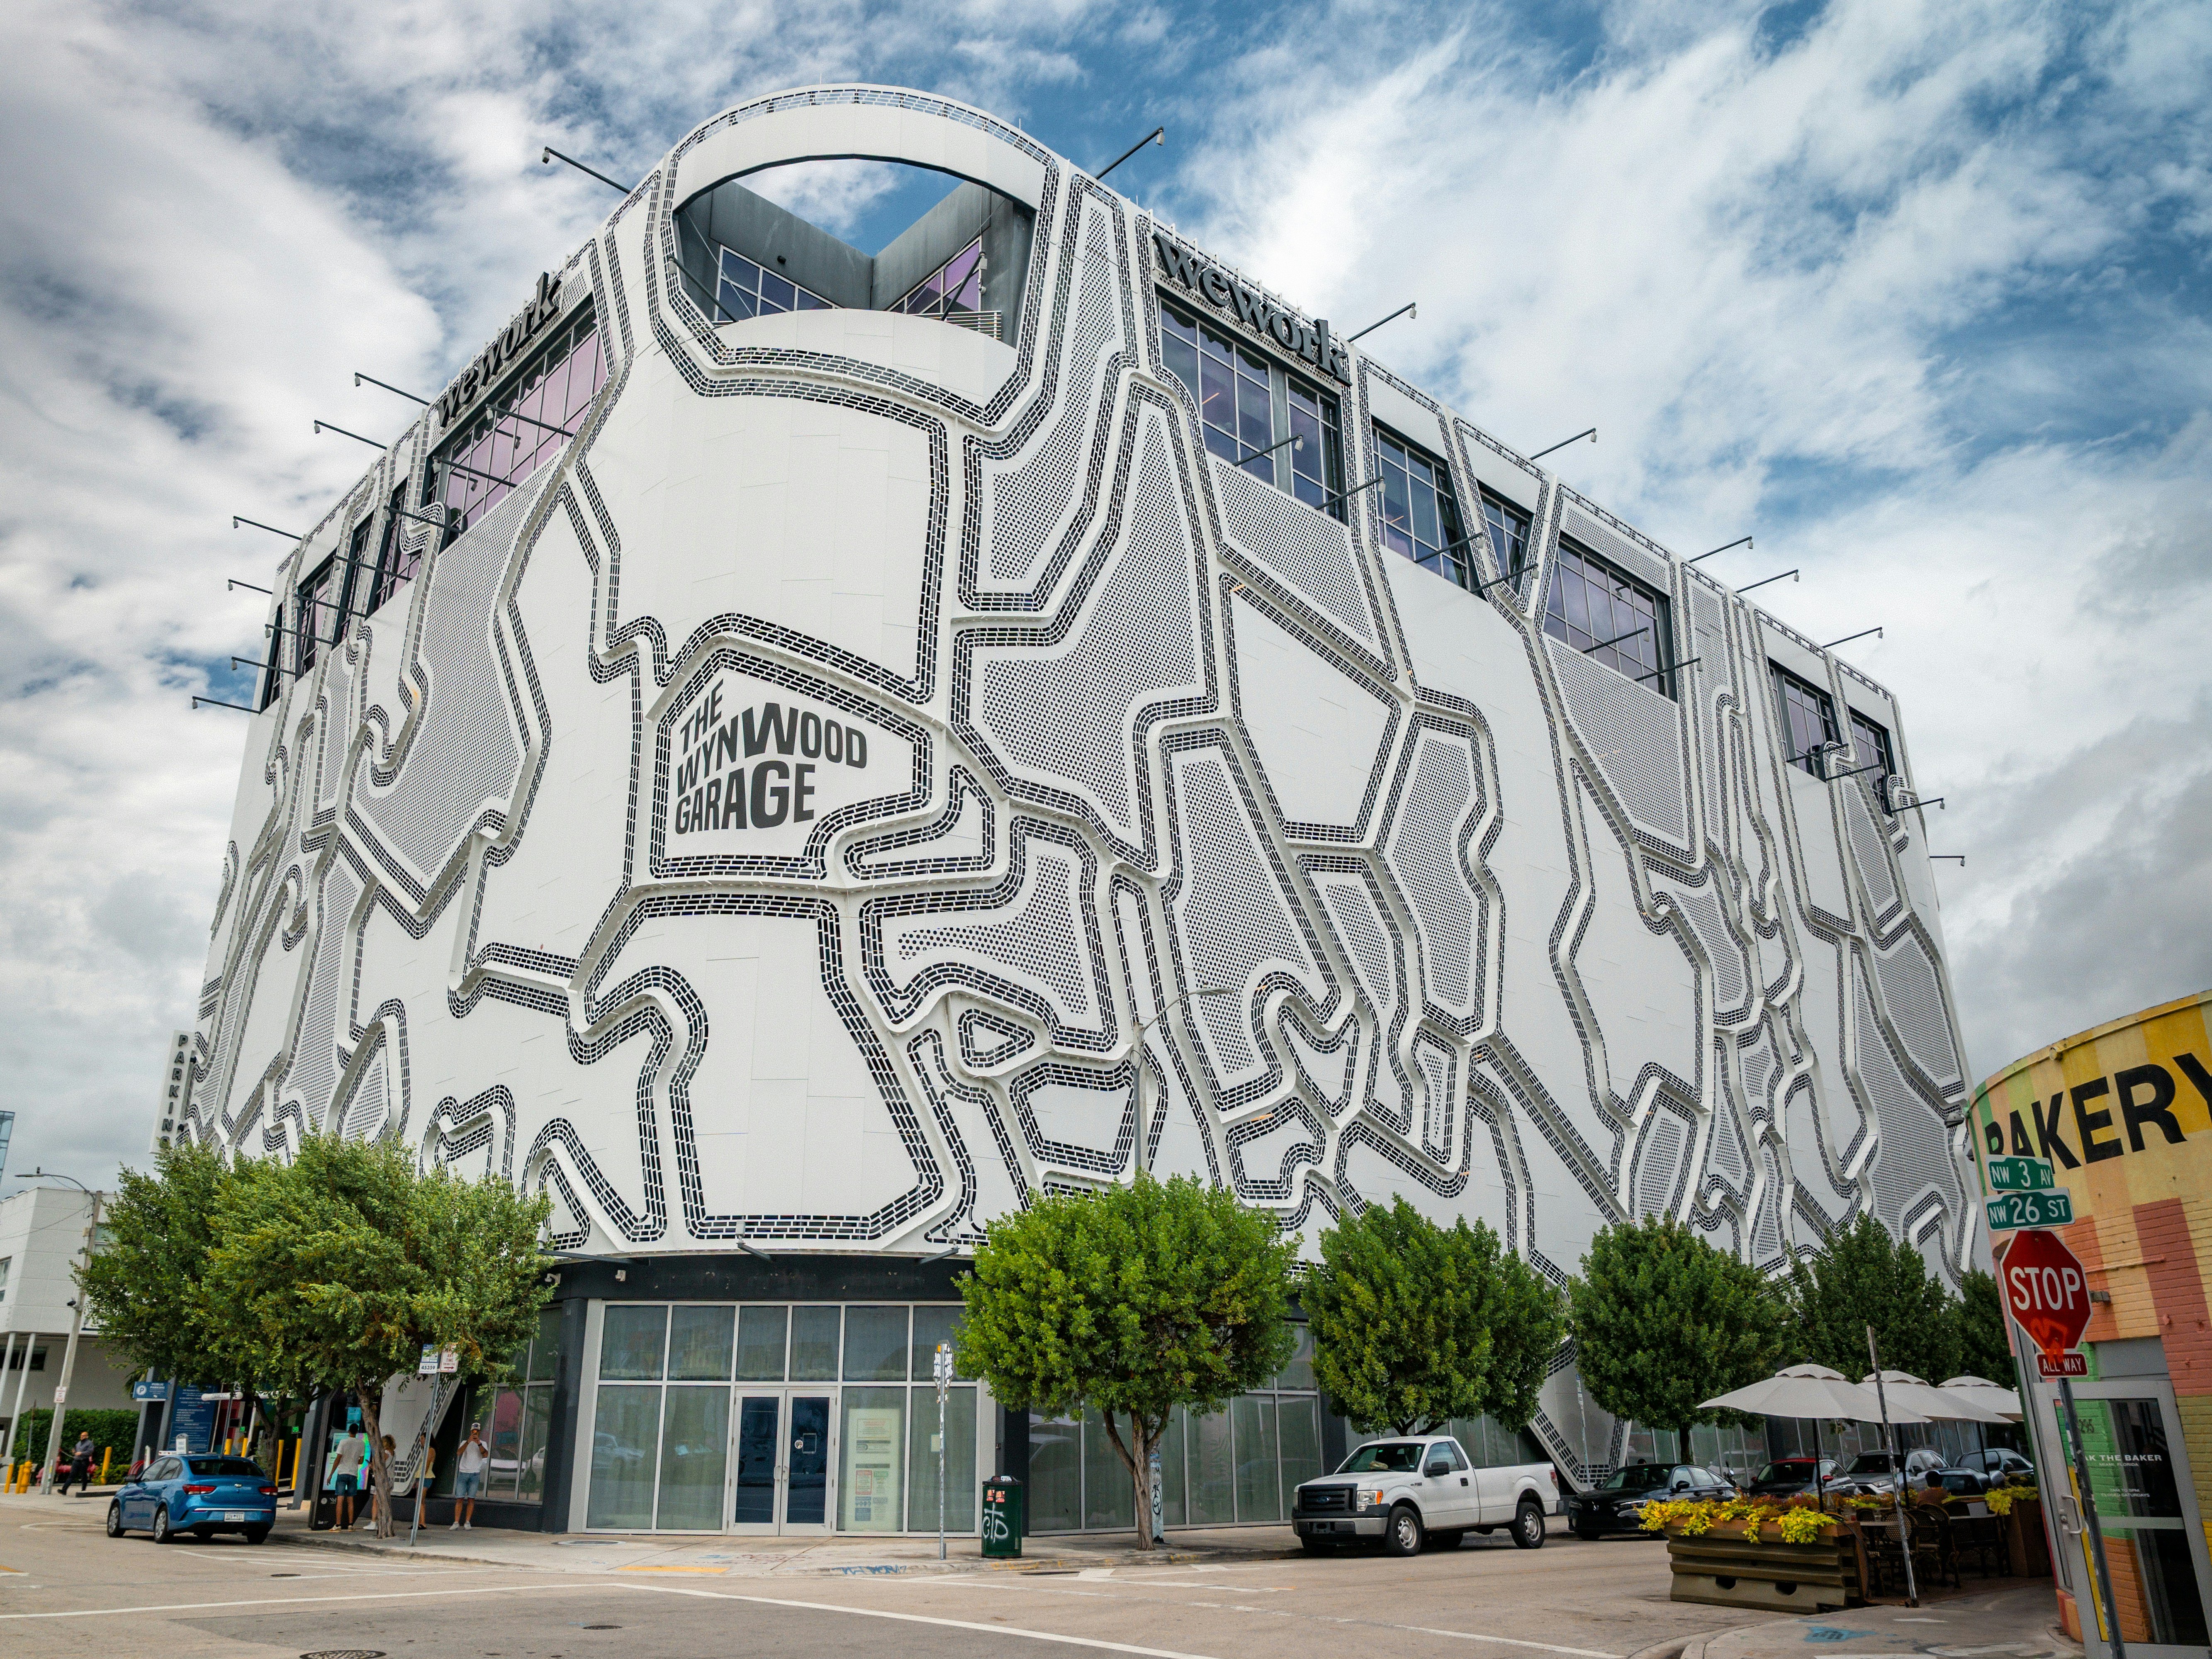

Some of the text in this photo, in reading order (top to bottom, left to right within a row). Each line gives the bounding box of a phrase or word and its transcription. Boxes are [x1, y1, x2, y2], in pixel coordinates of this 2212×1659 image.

[1151, 233, 1353, 387] wework
[437, 272, 562, 427] wework
[678, 702, 867, 798] WYNWOOD
[680, 678, 723, 755] THE
[675, 760, 815, 834] GARAGE
[1989, 1196, 2066, 1224] NW 26 ST
[1991, 1161, 2051, 1187] NW 3 AV
[2010, 1267, 2081, 1310] STOP
[2043, 1358, 2081, 1372] ALL WAY
